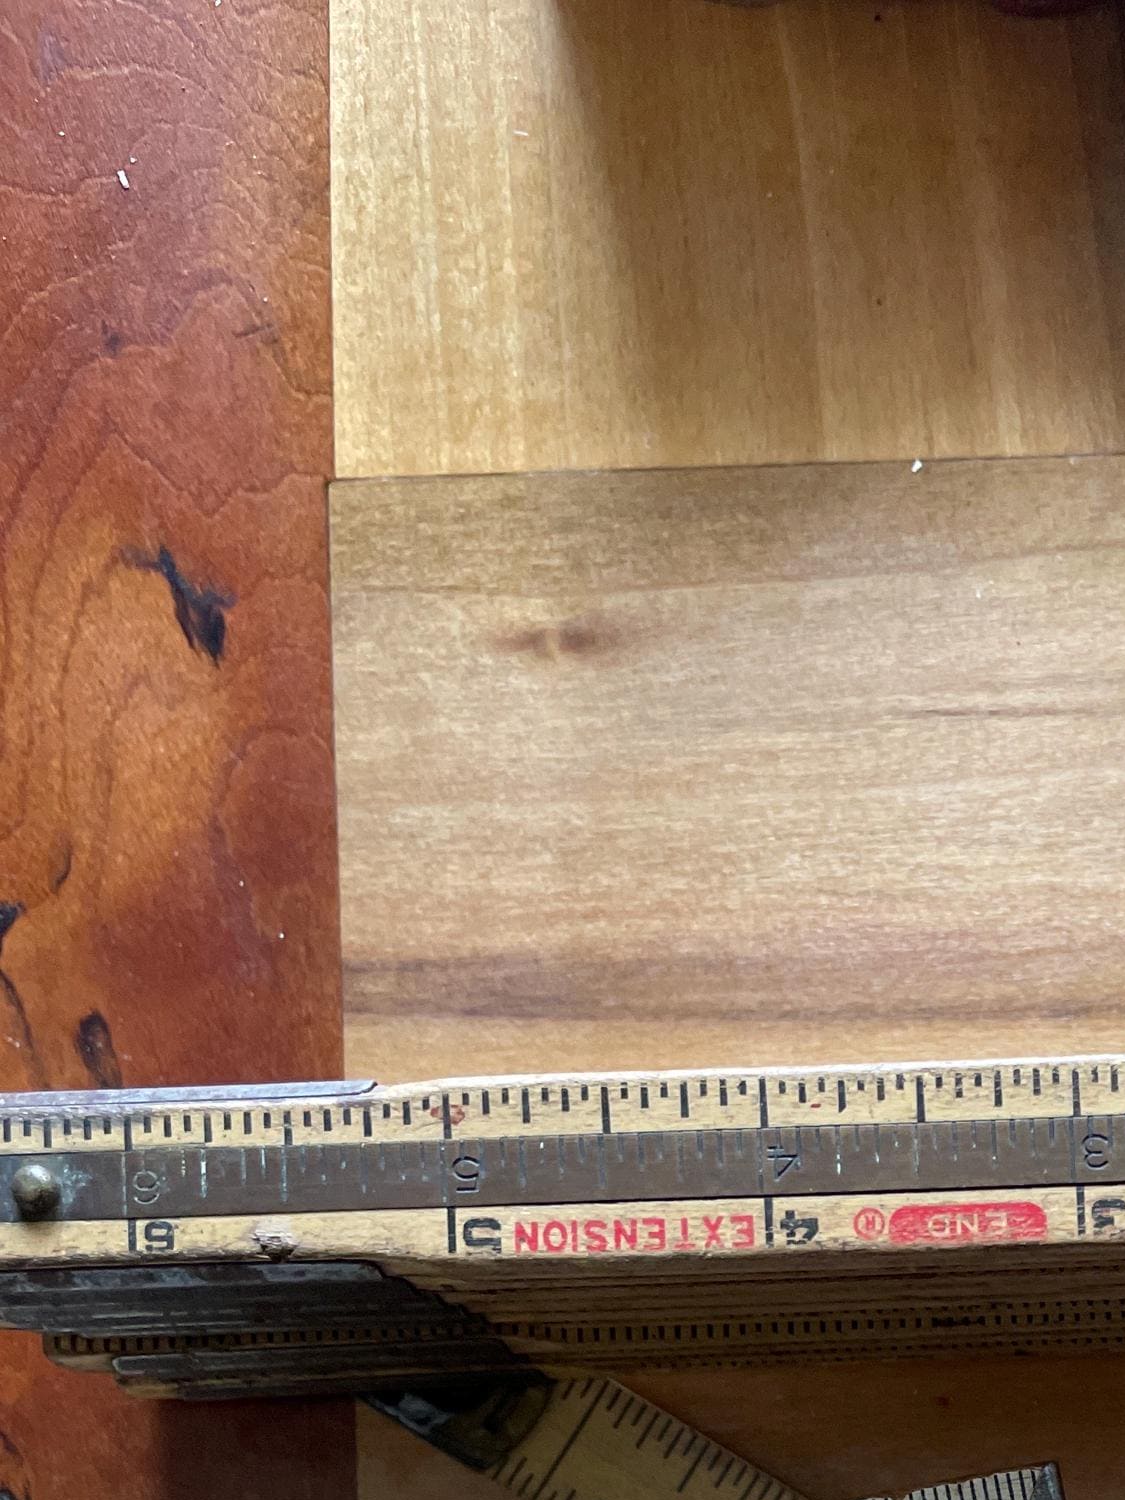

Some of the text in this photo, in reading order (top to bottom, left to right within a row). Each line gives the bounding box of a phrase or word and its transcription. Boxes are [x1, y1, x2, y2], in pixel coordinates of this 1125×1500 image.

[767, 1144, 799, 1182] 4
[1081, 1133, 1110, 1170] 3
[132, 1170, 161, 1204] 6
[452, 1155, 481, 1193] 5
[143, 1220, 175, 1251] 6
[514, 1213, 756, 1254] EXTENSION
[780, 1210, 819, 1246] 4
[926, 1210, 1009, 1238] END
